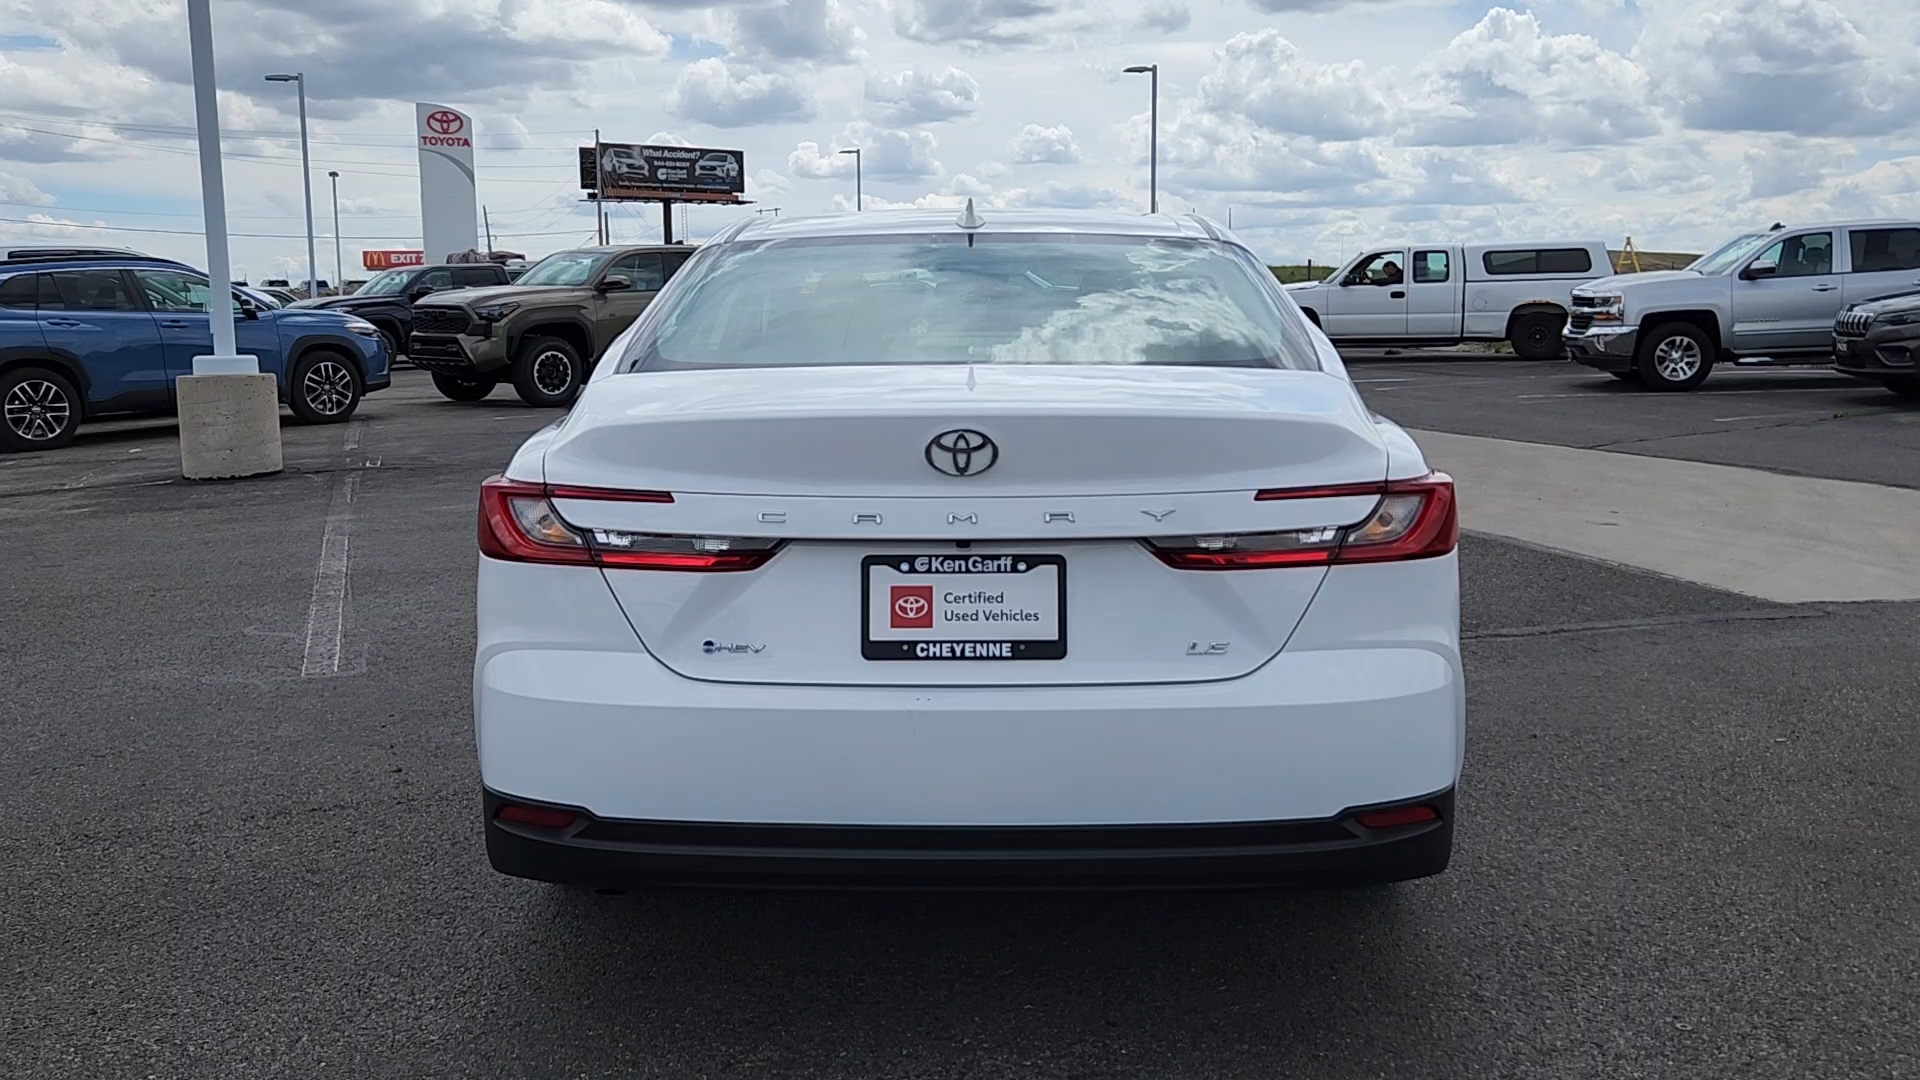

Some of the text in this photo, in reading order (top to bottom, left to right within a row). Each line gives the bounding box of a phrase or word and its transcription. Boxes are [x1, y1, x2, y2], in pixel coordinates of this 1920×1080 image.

[420, 136, 471, 147] TOYOTA
[642, 148, 700, 160] What Accident?
[391, 253, 418, 264] EXIT
[757, 510, 1177, 526] CAMRY
[931, 556, 966, 572] Ken
[967, 556, 1013, 572] Garff
[943, 591, 1004, 604] Certified
[944, 609, 1040, 622] Used Vehicles
[916, 643, 1012, 657] CHEYENNE
[1186, 640, 1231, 656] LE
